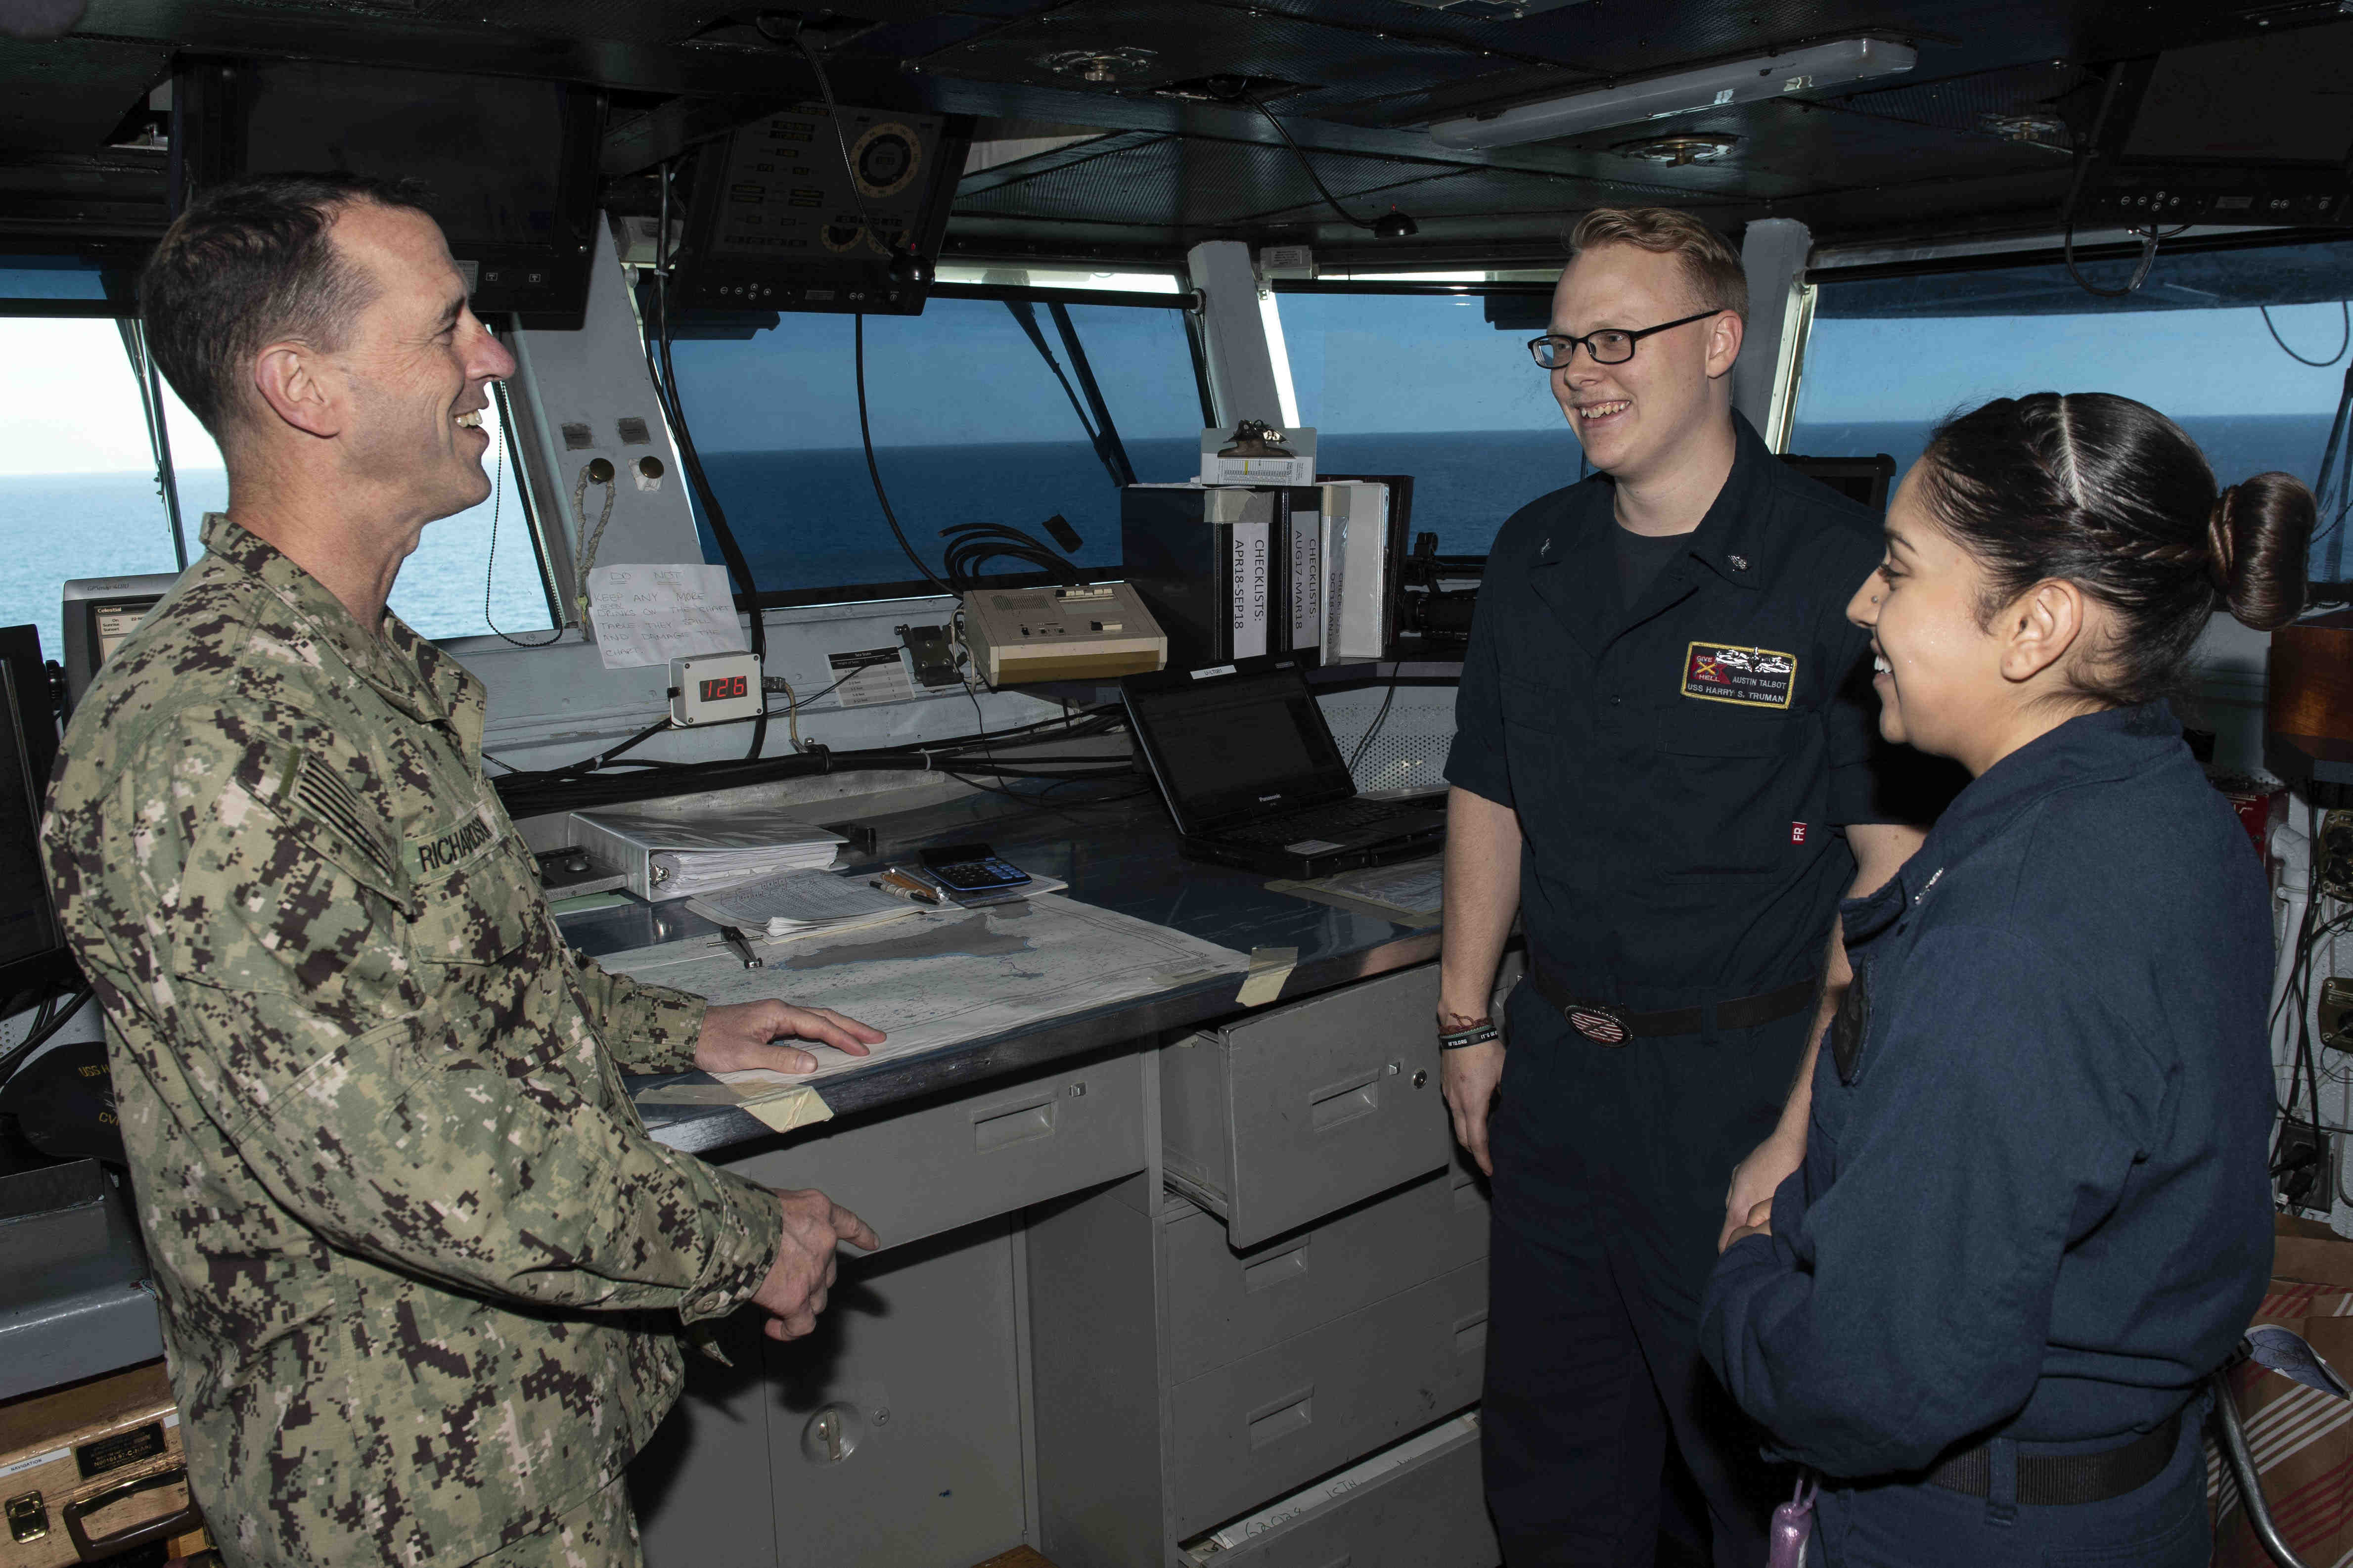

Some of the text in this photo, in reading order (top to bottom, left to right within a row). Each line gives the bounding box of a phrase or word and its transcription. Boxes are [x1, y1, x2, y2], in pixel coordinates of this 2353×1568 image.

[611, 571, 682, 581] DO NOT
[1254, 539, 1265, 621] CHECKLISTS:
[1234, 539, 1244, 629] APR18-SEP18
[594, 592, 705, 602] KEEP ANY MORE
[597, 609, 637, 617] DRINKS
[604, 632, 629, 641] AND
[641, 631, 689, 641] DAMAGE
[1698, 673, 1720, 682] HELL
[1732, 675, 1787, 689] AUSTIN TALBOT
[706, 675, 745, 698] 126
[1687, 683, 1704, 692] USS
[1706, 686, 1734, 696] HARRY
[1749, 692, 1784, 703] TRUMAN
[1793, 827, 1805, 841] FR
[78, 1065, 101, 1076] USS
[10, 1458, 43, 1471] NAVIGATION
